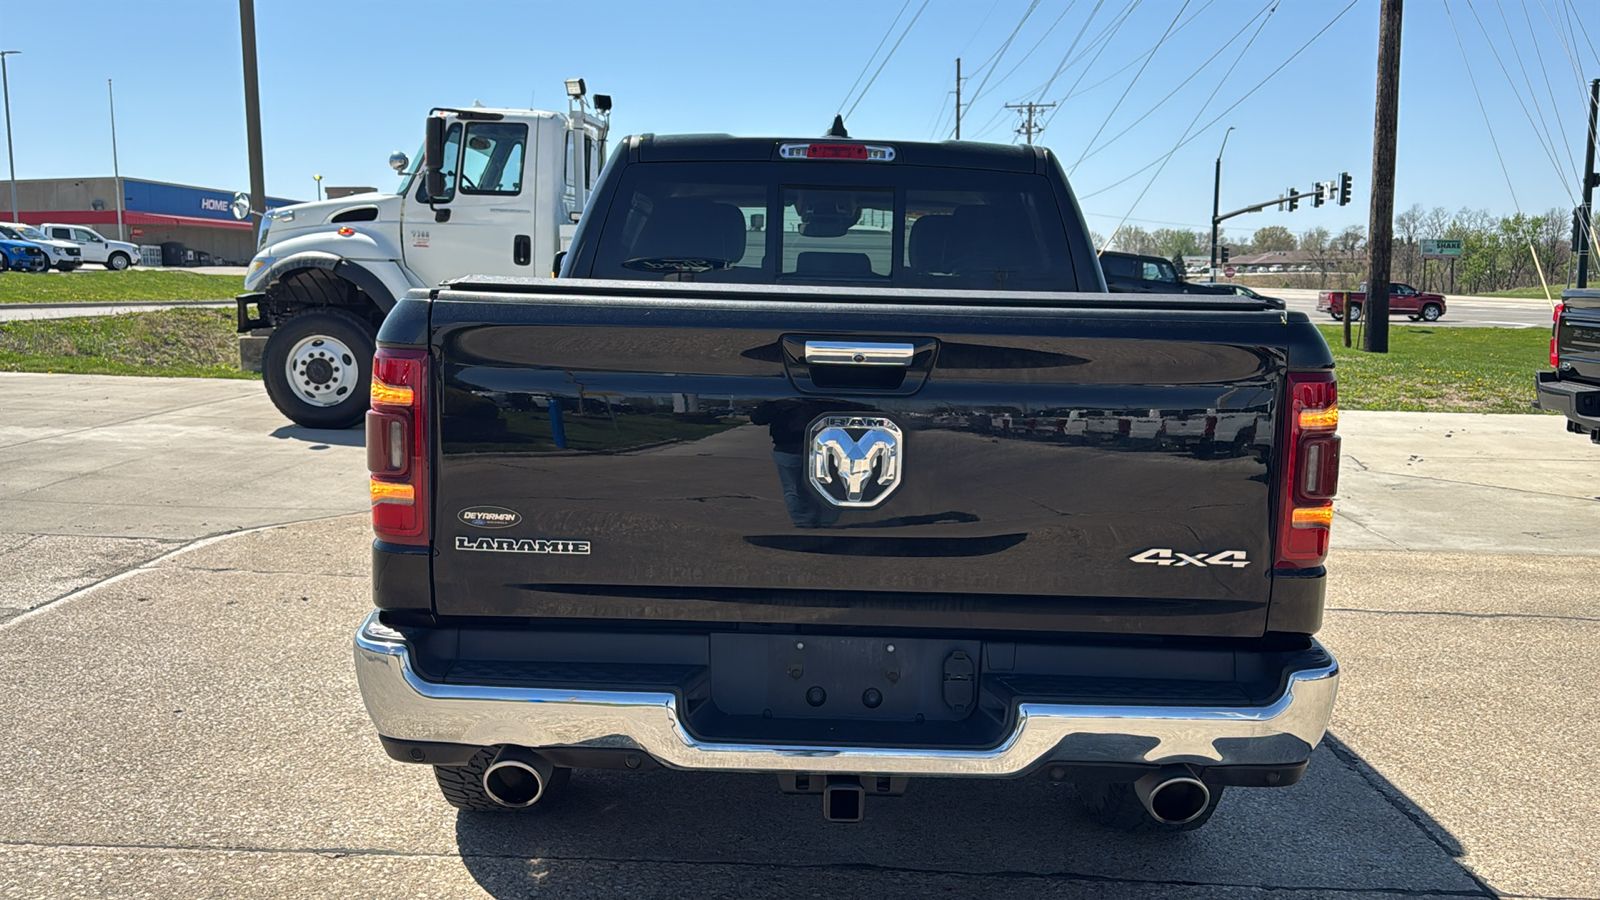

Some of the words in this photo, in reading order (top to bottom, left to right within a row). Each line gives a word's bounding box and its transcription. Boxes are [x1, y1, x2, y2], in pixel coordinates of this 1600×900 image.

[201, 198, 229, 212] HOME
[828, 417, 887, 428] RAM
[463, 511, 516, 521] DEYARMAN
[455, 536, 591, 555] LARAMIE
[1129, 548, 1251, 568] 4x4
